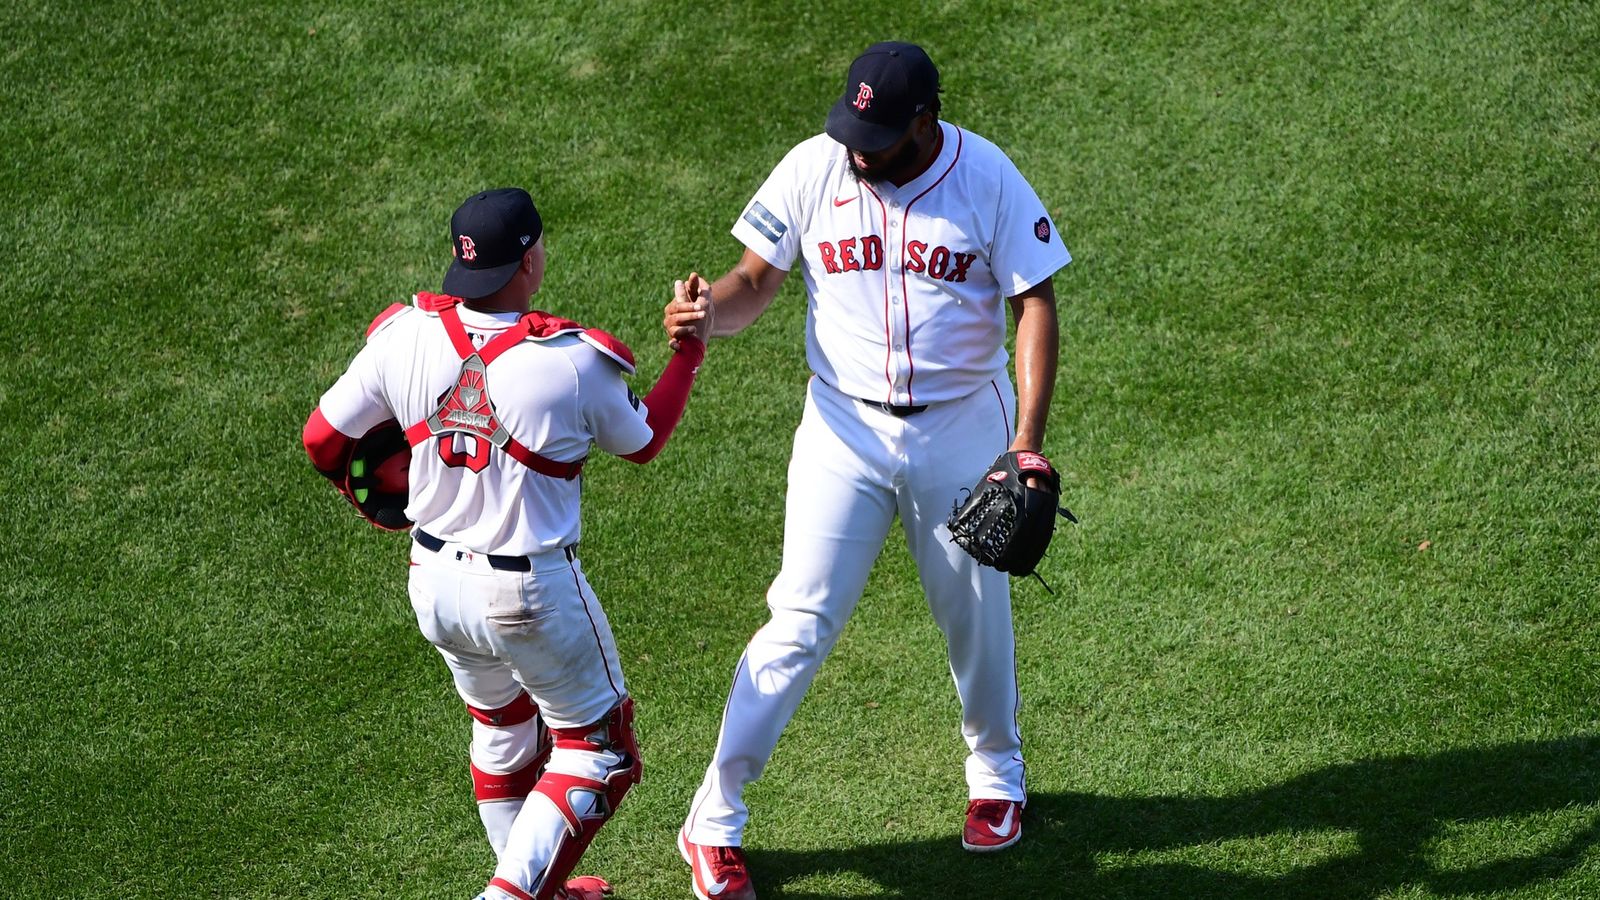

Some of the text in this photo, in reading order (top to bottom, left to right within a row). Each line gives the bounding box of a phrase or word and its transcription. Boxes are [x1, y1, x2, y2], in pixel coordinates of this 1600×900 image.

[853, 82, 874, 112] B
[459, 234, 478, 262] B
[818, 234, 977, 282] RED SOX
